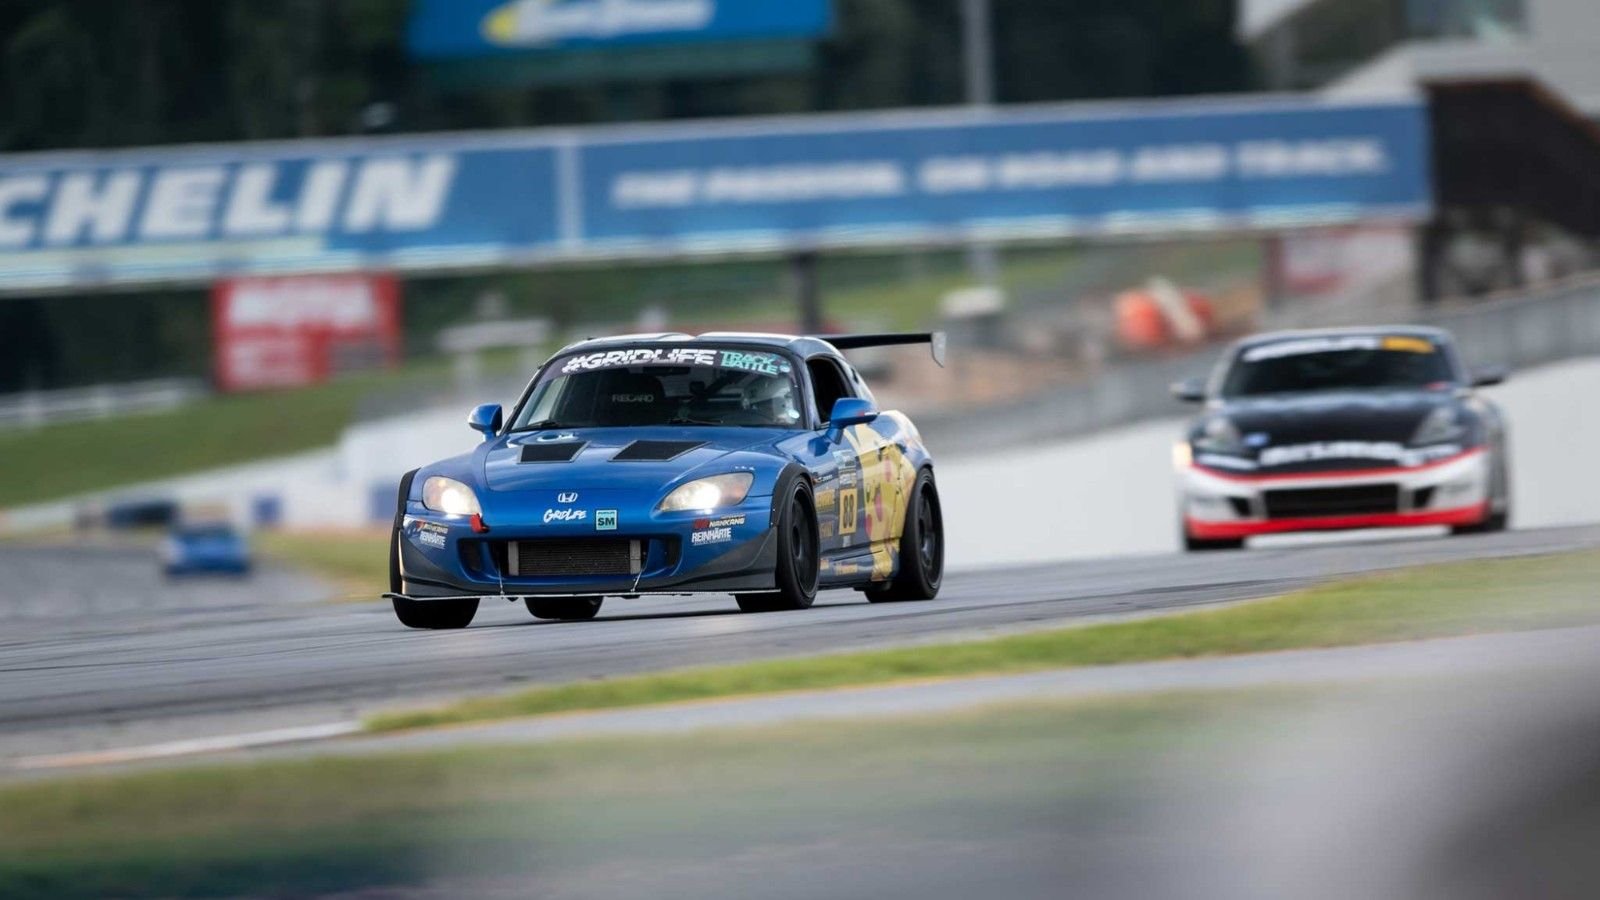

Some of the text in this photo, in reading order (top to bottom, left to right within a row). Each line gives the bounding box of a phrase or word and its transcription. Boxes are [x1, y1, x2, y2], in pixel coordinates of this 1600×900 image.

[561, 348, 717, 374] #GRIDLIFE
[719, 350, 776, 365] TRACK
[721, 359, 779, 376] BATTLE
[843, 493, 855, 529] 88
[597, 517, 615, 527] SM
